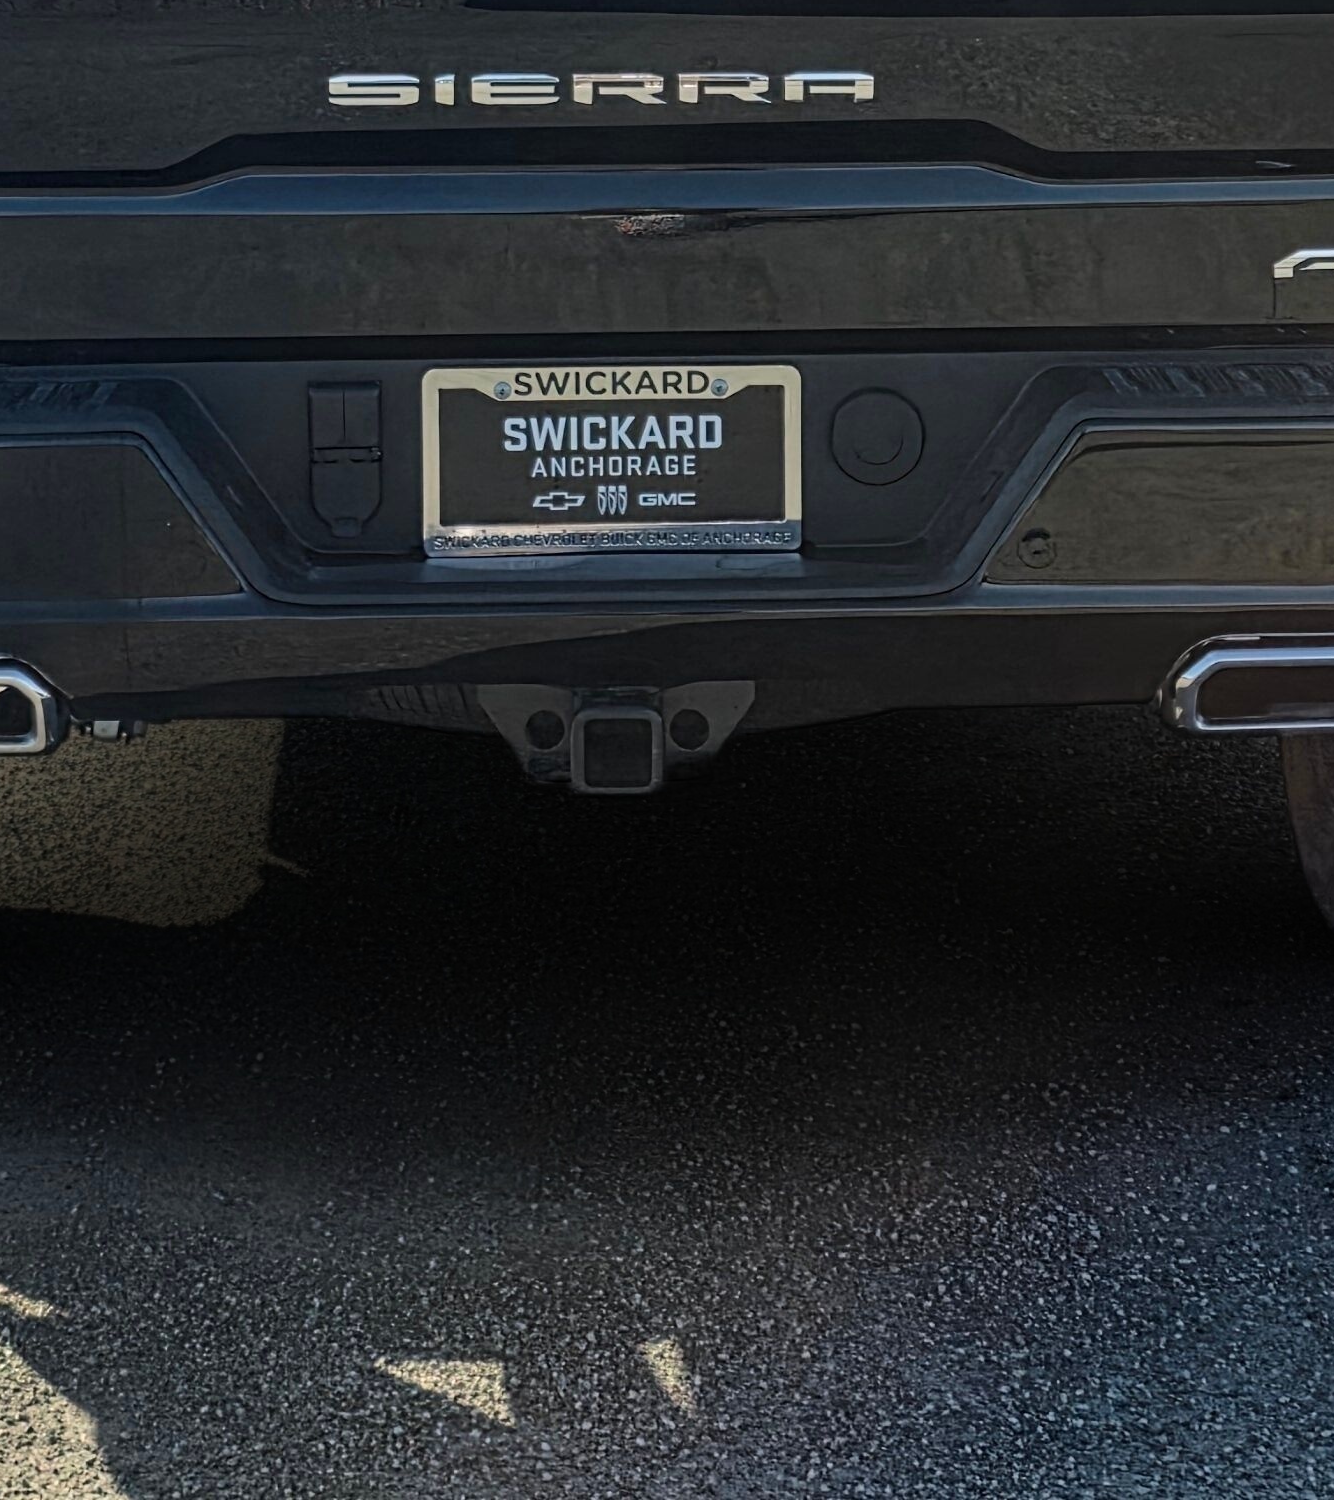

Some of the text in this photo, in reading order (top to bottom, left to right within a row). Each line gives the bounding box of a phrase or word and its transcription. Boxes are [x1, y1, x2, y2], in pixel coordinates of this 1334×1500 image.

[328, 73, 875, 105] SIERRA
[514, 369, 710, 396] SWICKARD
[503, 414, 723, 453] SWICKARD
[531, 455, 697, 478] ANCHORAGE
[638, 493, 697, 507] GMC
[434, 534, 511, 550] SWICKARD
[513, 533, 597, 548] CHEVROLET
[601, 532, 643, 547] BUICK
[646, 532, 677, 546] GMC
[701, 531, 792, 546] ANCHORAGE
